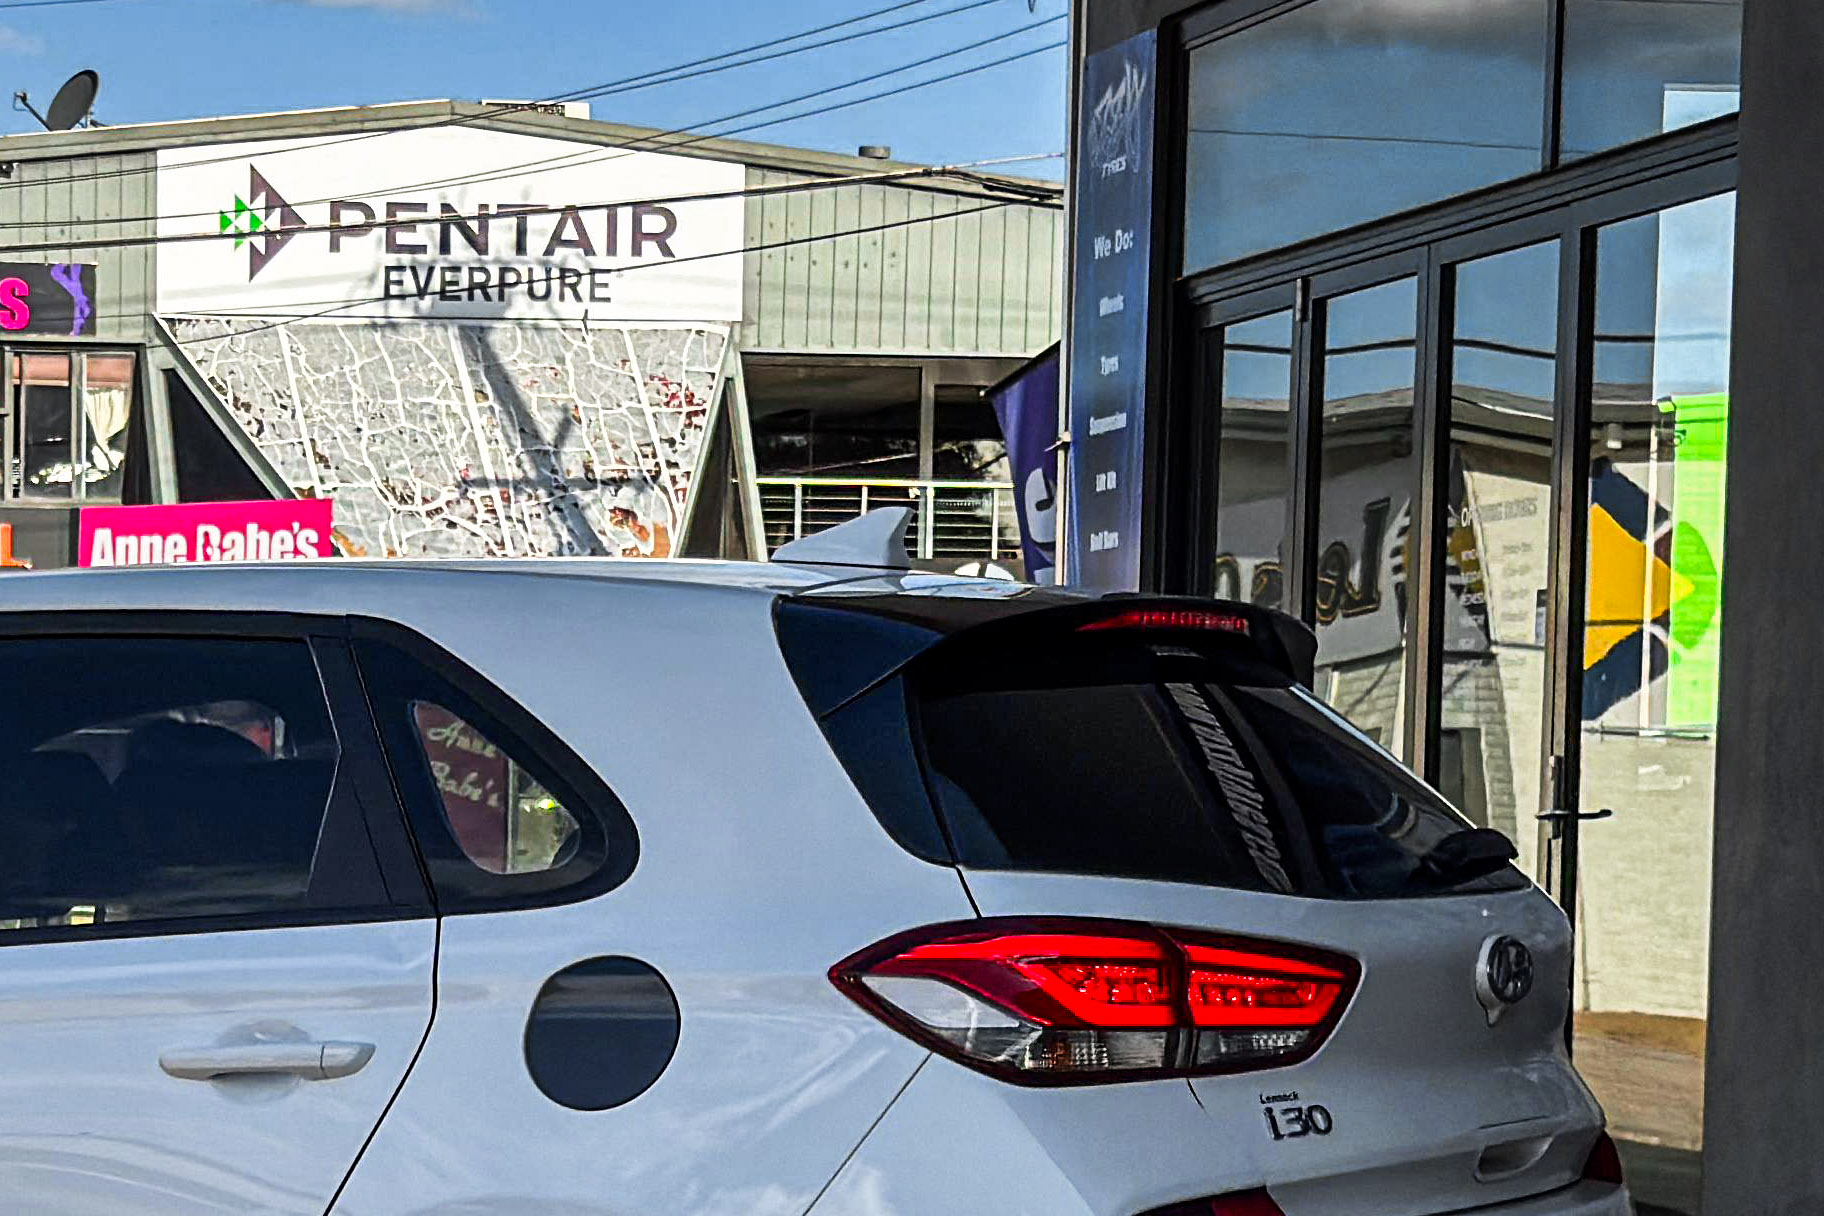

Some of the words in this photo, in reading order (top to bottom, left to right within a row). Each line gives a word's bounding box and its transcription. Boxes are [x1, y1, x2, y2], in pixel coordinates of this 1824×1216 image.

[329, 200, 677, 258] PENTAIR
[383, 265, 612, 303] EVERPURE
[90, 527, 187, 567] Anne
